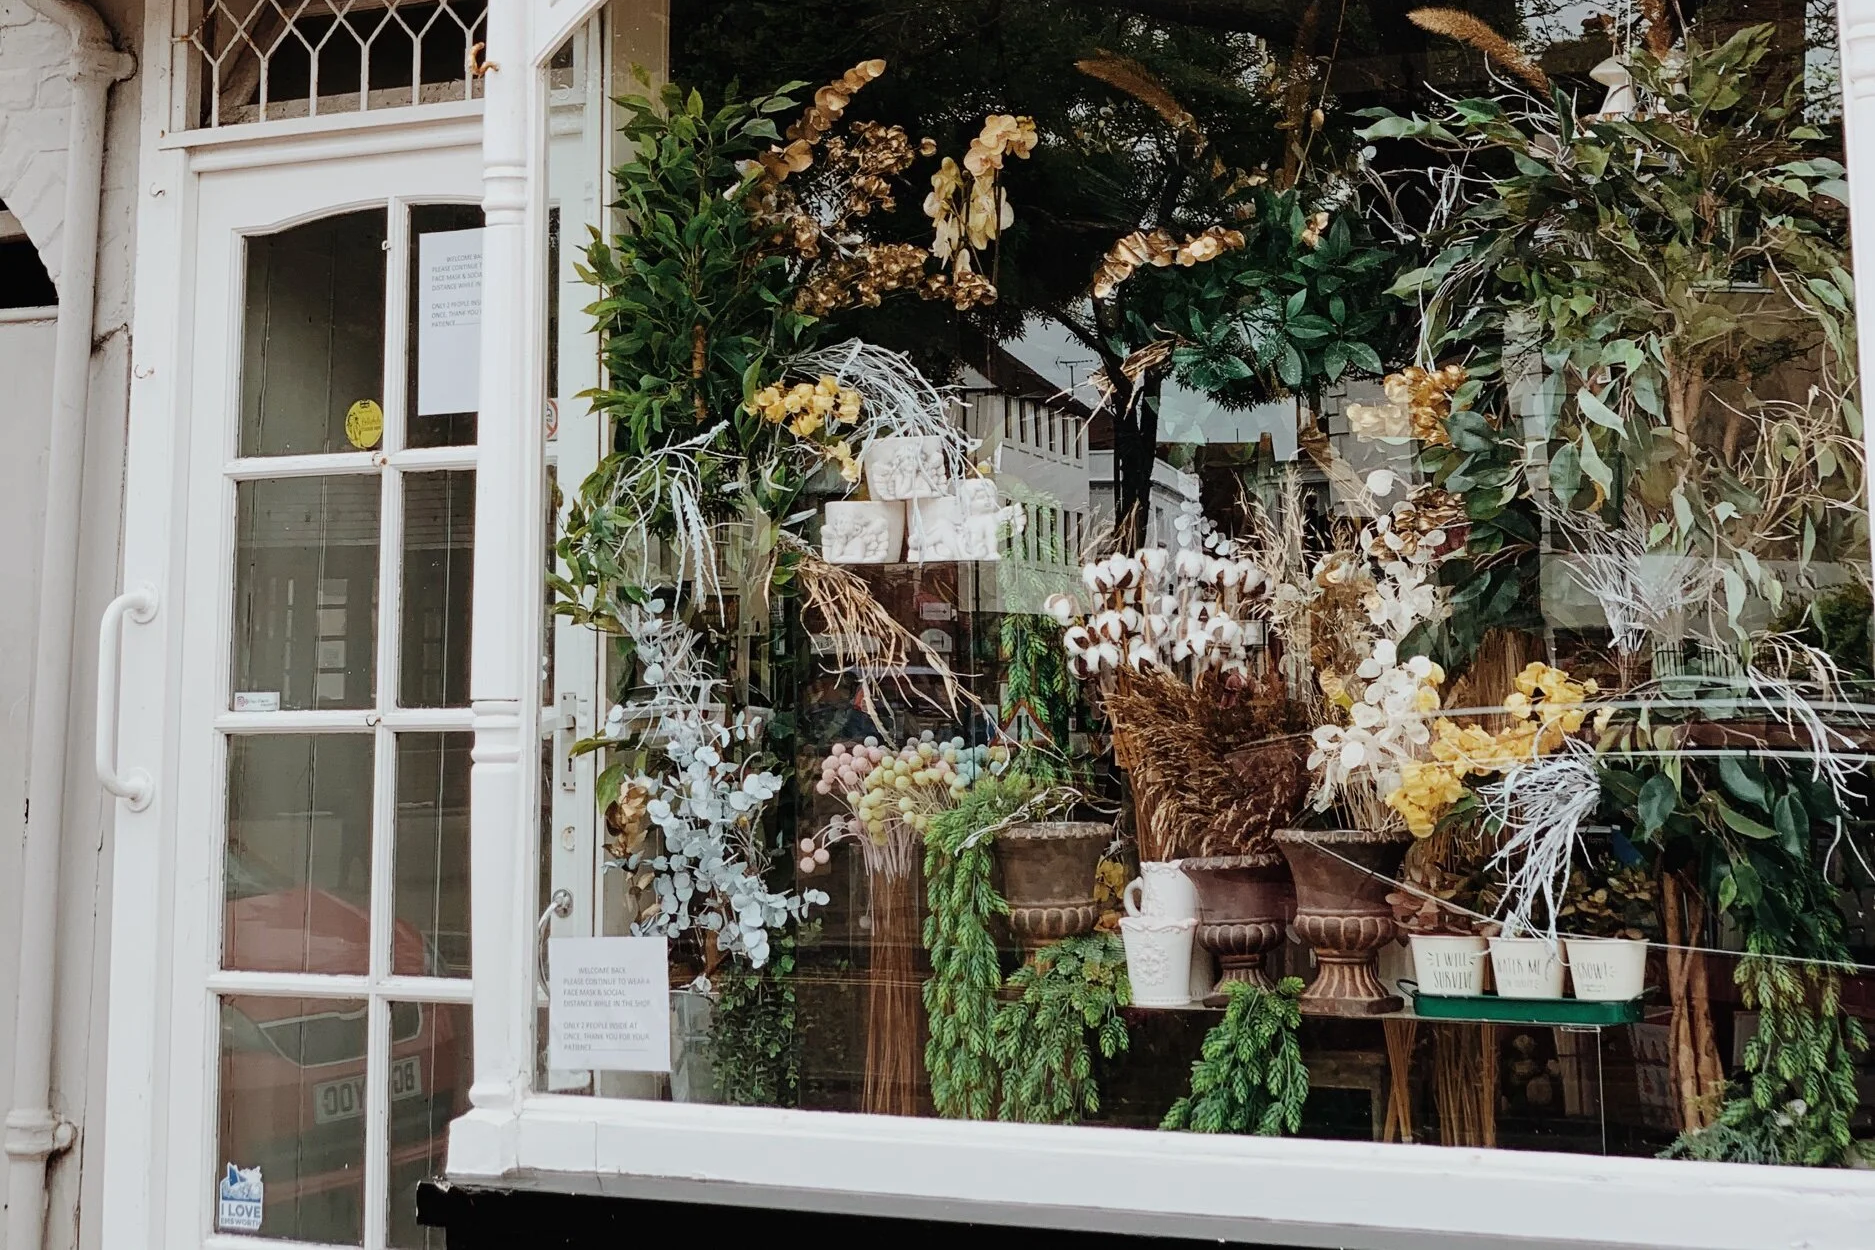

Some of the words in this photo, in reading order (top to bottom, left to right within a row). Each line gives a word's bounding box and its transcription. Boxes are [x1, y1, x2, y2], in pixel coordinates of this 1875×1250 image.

[446, 254, 471, 263] WELCOME
[431, 265, 450, 273] PLEASE
[451, 262, 478, 271] CONTINUE
[431, 274, 445, 282] FACE
[446, 273, 461, 281] MASK
[431, 282, 457, 291] DISTANCE
[458, 280, 474, 289] WHILE
[431, 302, 445, 310] ONLY
[450, 300, 469, 308] PEOPLE
[1434, 952, 1440, 967] I
[1443, 951, 1466, 967] WILL
[578, 966, 609, 974] WELCOME
[611, 966, 626, 974] BACK
[563, 977, 584, 986] PLEASE
[585, 977, 616, 986] CONTINUE
[618, 977, 627, 985] TO
[627, 977, 645, 985] WEAR
[1433, 969, 1472, 990] SURVIVE
[603, 989, 625, 997] SOCIAL
[563, 999, 592, 1008] DISTANCE
[593, 999, 612, 1008] WHILE
[613, 999, 621, 1008] IN
[621, 999, 633, 1008] THE
[563, 1021, 580, 1030] ONLY
[585, 1021, 608, 1029] PEOPLE
[584, 1032, 604, 1040] THANK
[605, 1032, 618, 1040] YOU
[618, 1032, 631, 1041] FOR
[632, 1032, 650, 1041] YOUR
[221, 1202, 225, 1216] I
[228, 1203, 262, 1218] LOVE
